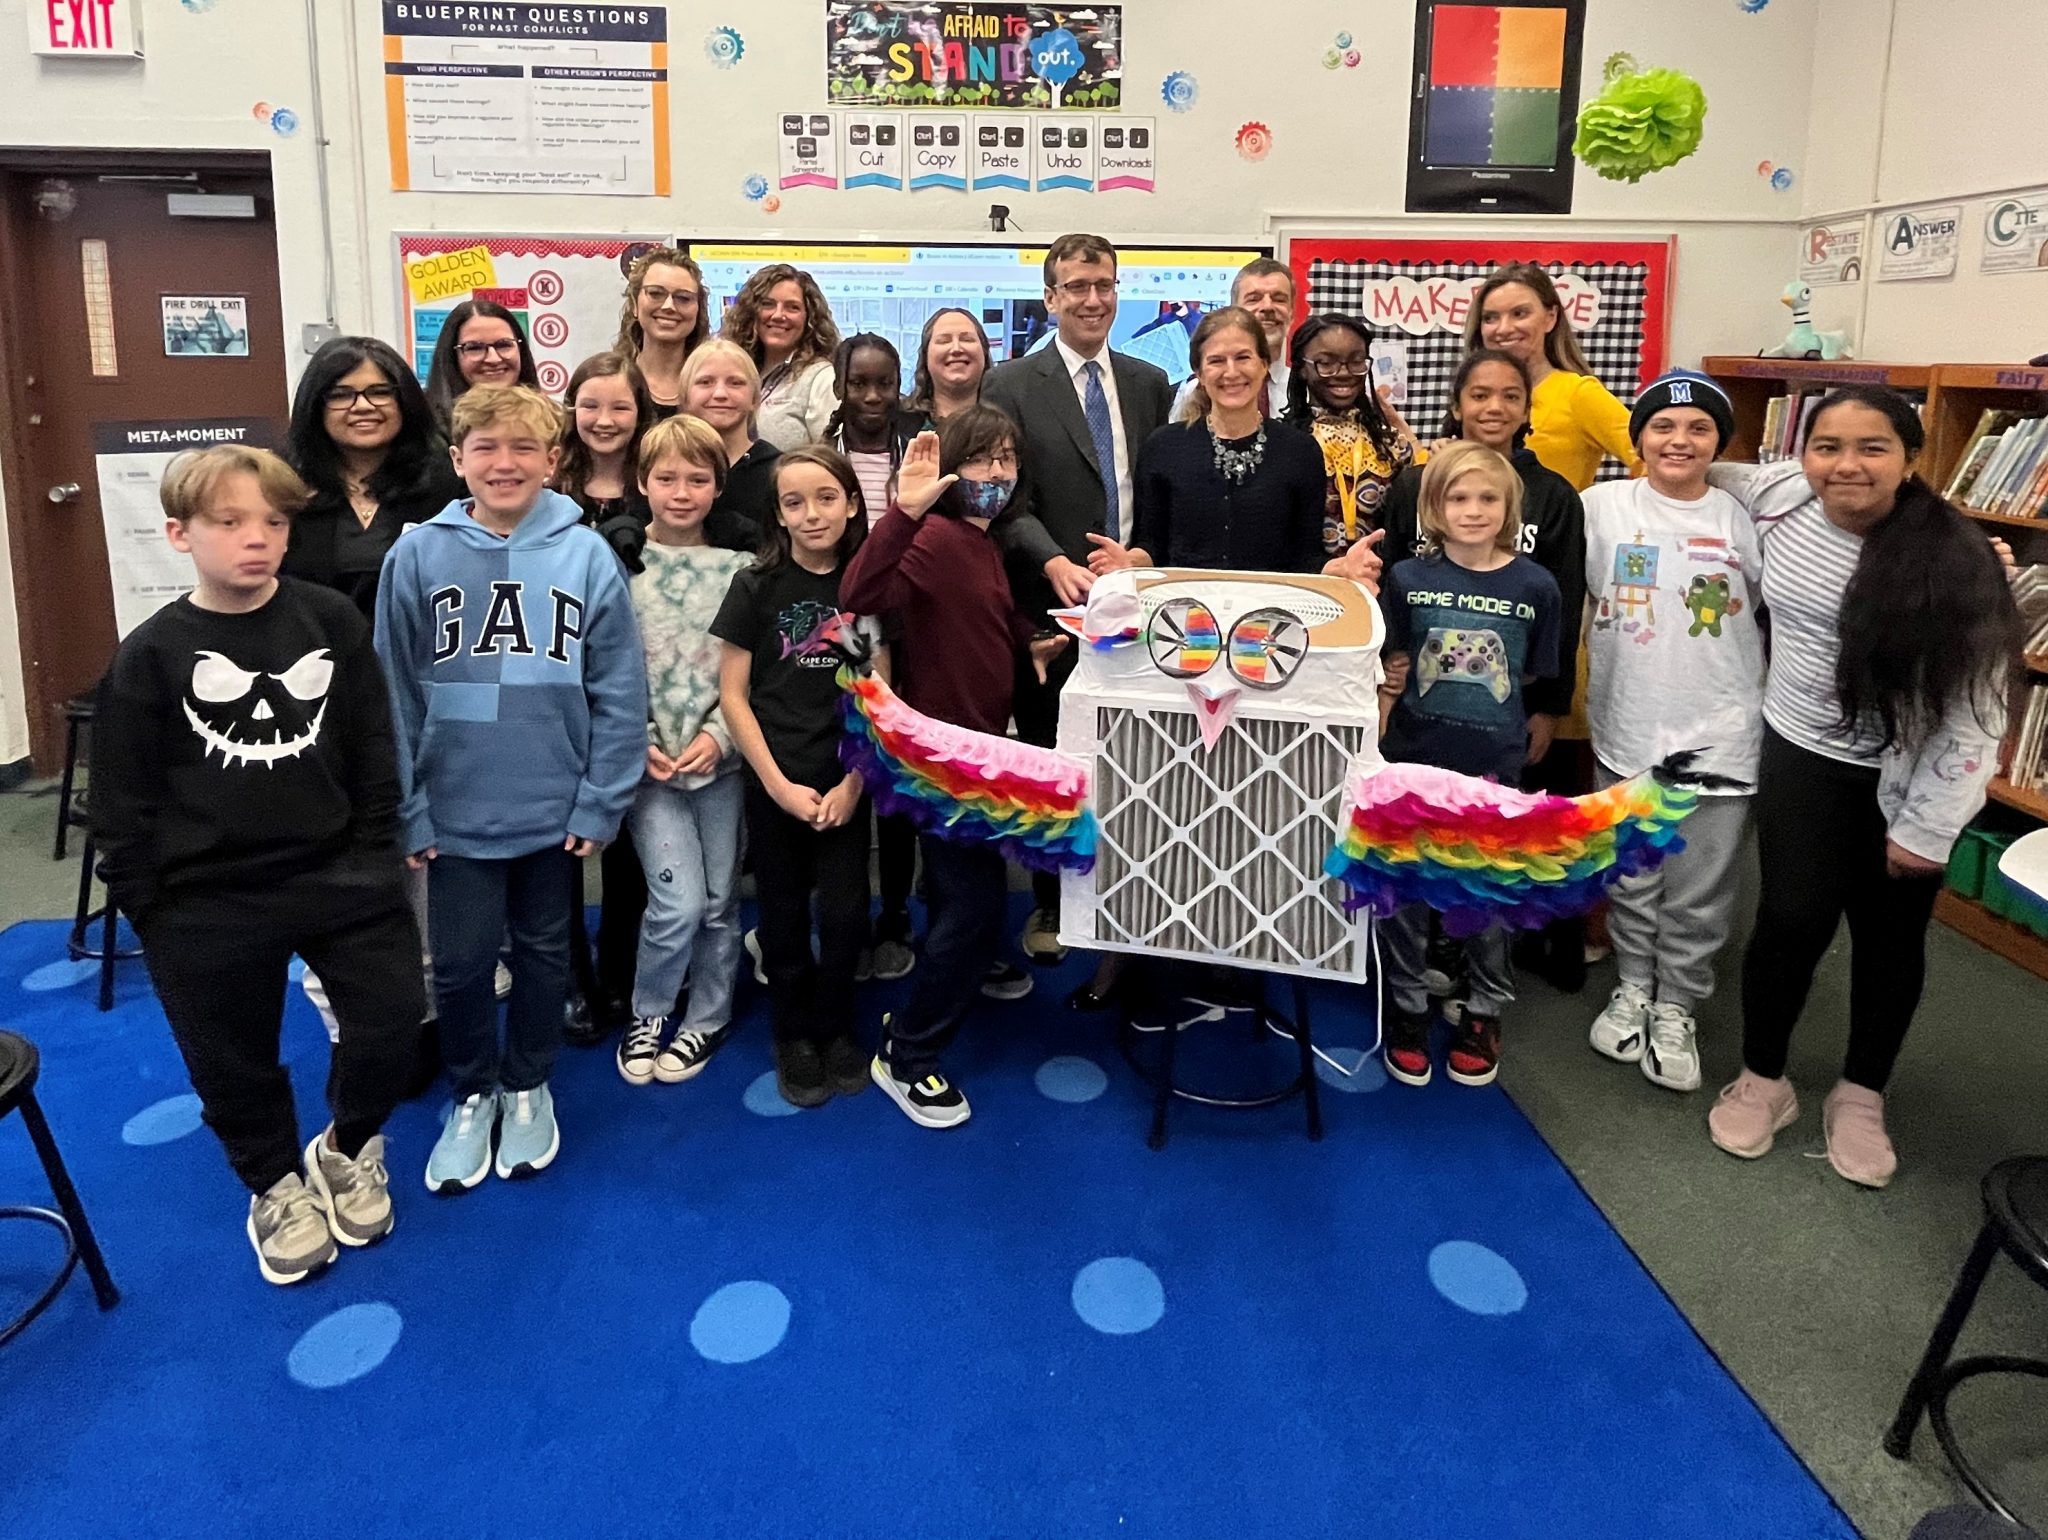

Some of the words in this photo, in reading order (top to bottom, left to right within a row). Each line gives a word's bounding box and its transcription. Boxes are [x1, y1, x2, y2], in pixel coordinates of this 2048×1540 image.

[47, 0, 114, 48] EXIT
[397, 4, 517, 20] BLUEPRINT
[528, 8, 650, 25] QUESTIONS
[462, 23, 484, 32] FOR
[489, 23, 518, 33] PAST
[523, 24, 588, 35] CONFLICTS
[944, 14, 1000, 38] AFRAID
[1003, 13, 1030, 37] to
[416, 65, 438, 73] YOUR
[438, 65, 488, 74] PERSPECTIVE
[888, 42, 1025, 82] STAND
[1038, 47, 1076, 66] out.
[544, 68, 569, 76] OTHER
[608, 70, 657, 78] PERSPECTIVE
[859, 150, 885, 167] Cut
[917, 150, 956, 170] Copy
[981, 151, 1019, 169] Paste
[1046, 153, 1082, 169] Undo
[1101, 157, 1152, 169] Downloads
[1993, 203, 2039, 242] CITE
[1891, 216, 1956, 251] ANSWER
[410, 247, 486, 280] GOLDEN
[423, 270, 487, 299] AWARD
[164, 300, 187, 309] FIRE
[221, 300, 241, 310] EXIT
[1996, 371, 2044, 390] Fairy
[1668, 382, 1693, 404] M
[127, 427, 247, 443] META-MOMENT
[1407, 590, 1455, 607] GAME
[1458, 594, 1513, 616] MODE
[1515, 603, 1536, 621] ON
[431, 581, 584, 664] GAP
[800, 656, 820, 665] CAPE
